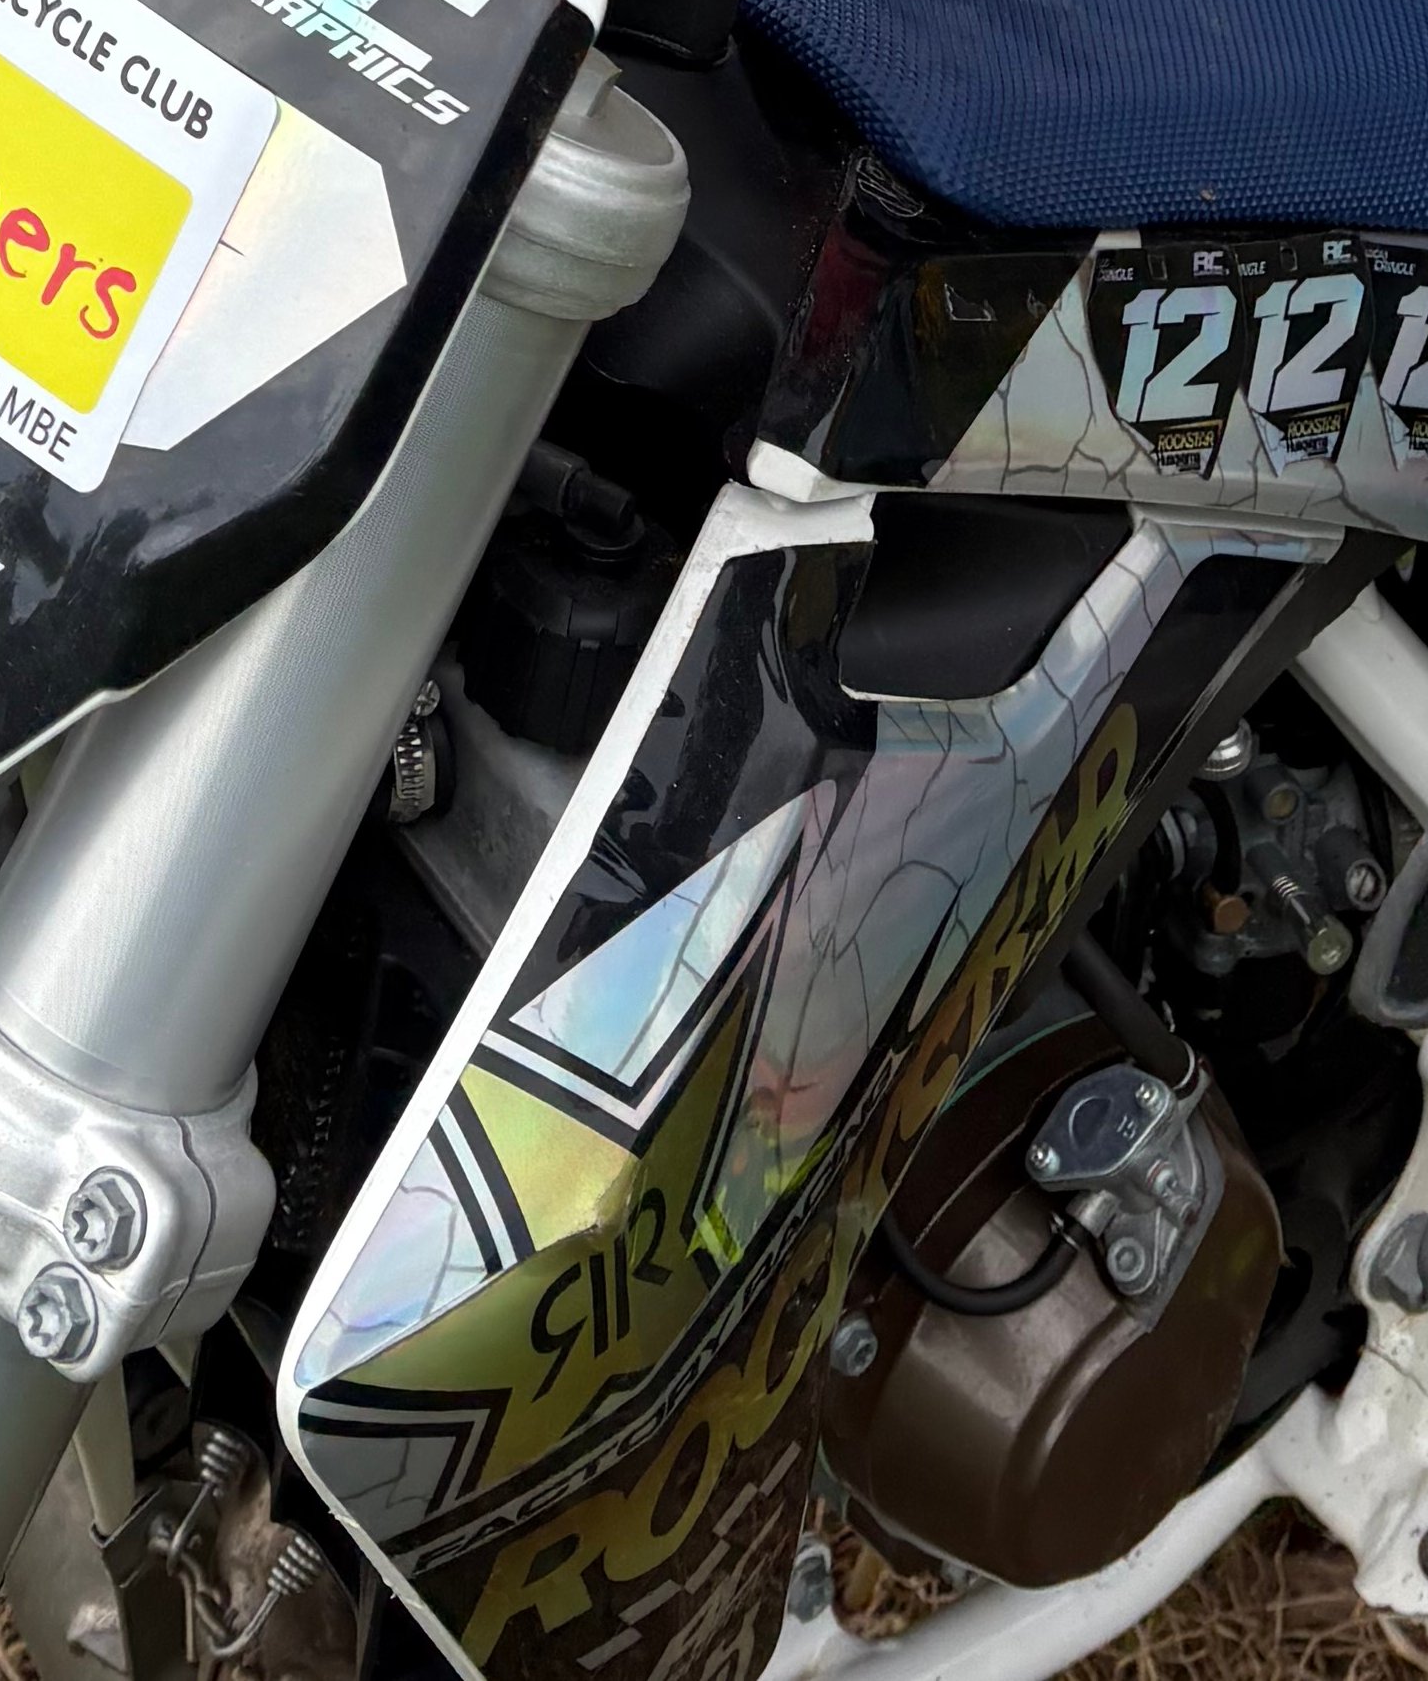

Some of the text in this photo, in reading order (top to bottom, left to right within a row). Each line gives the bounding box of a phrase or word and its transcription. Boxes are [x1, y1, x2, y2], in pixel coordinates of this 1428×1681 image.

[119, 35, 212, 142] CLUB
[1115, 285, 1237, 423] 12
[1247, 273, 1365, 413] 12
